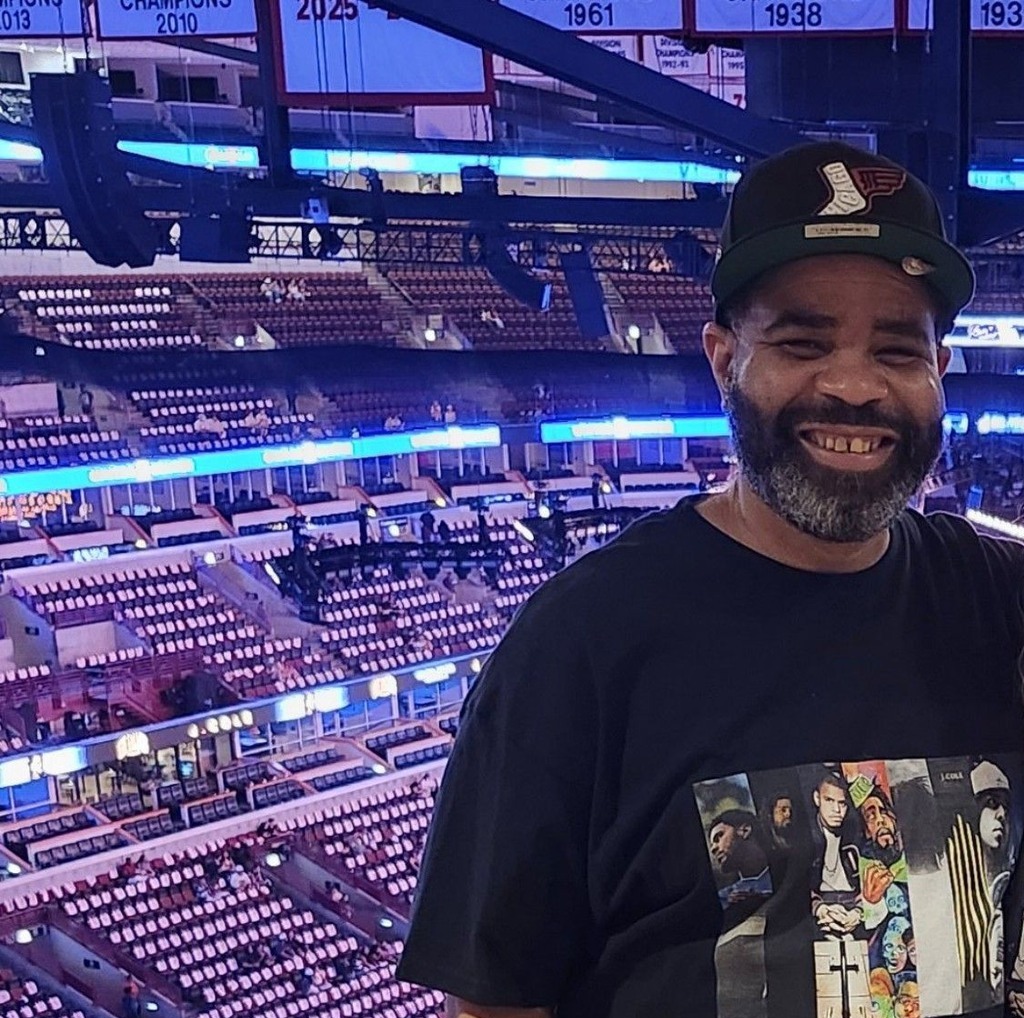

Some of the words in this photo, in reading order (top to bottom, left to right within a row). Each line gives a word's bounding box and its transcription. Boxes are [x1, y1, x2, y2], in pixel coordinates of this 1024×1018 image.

[0, 9, 31, 30] 013
[156, 13, 198, 34] 2010
[564, 3, 614, 26] 1961
[765, 3, 822, 26] 1938
